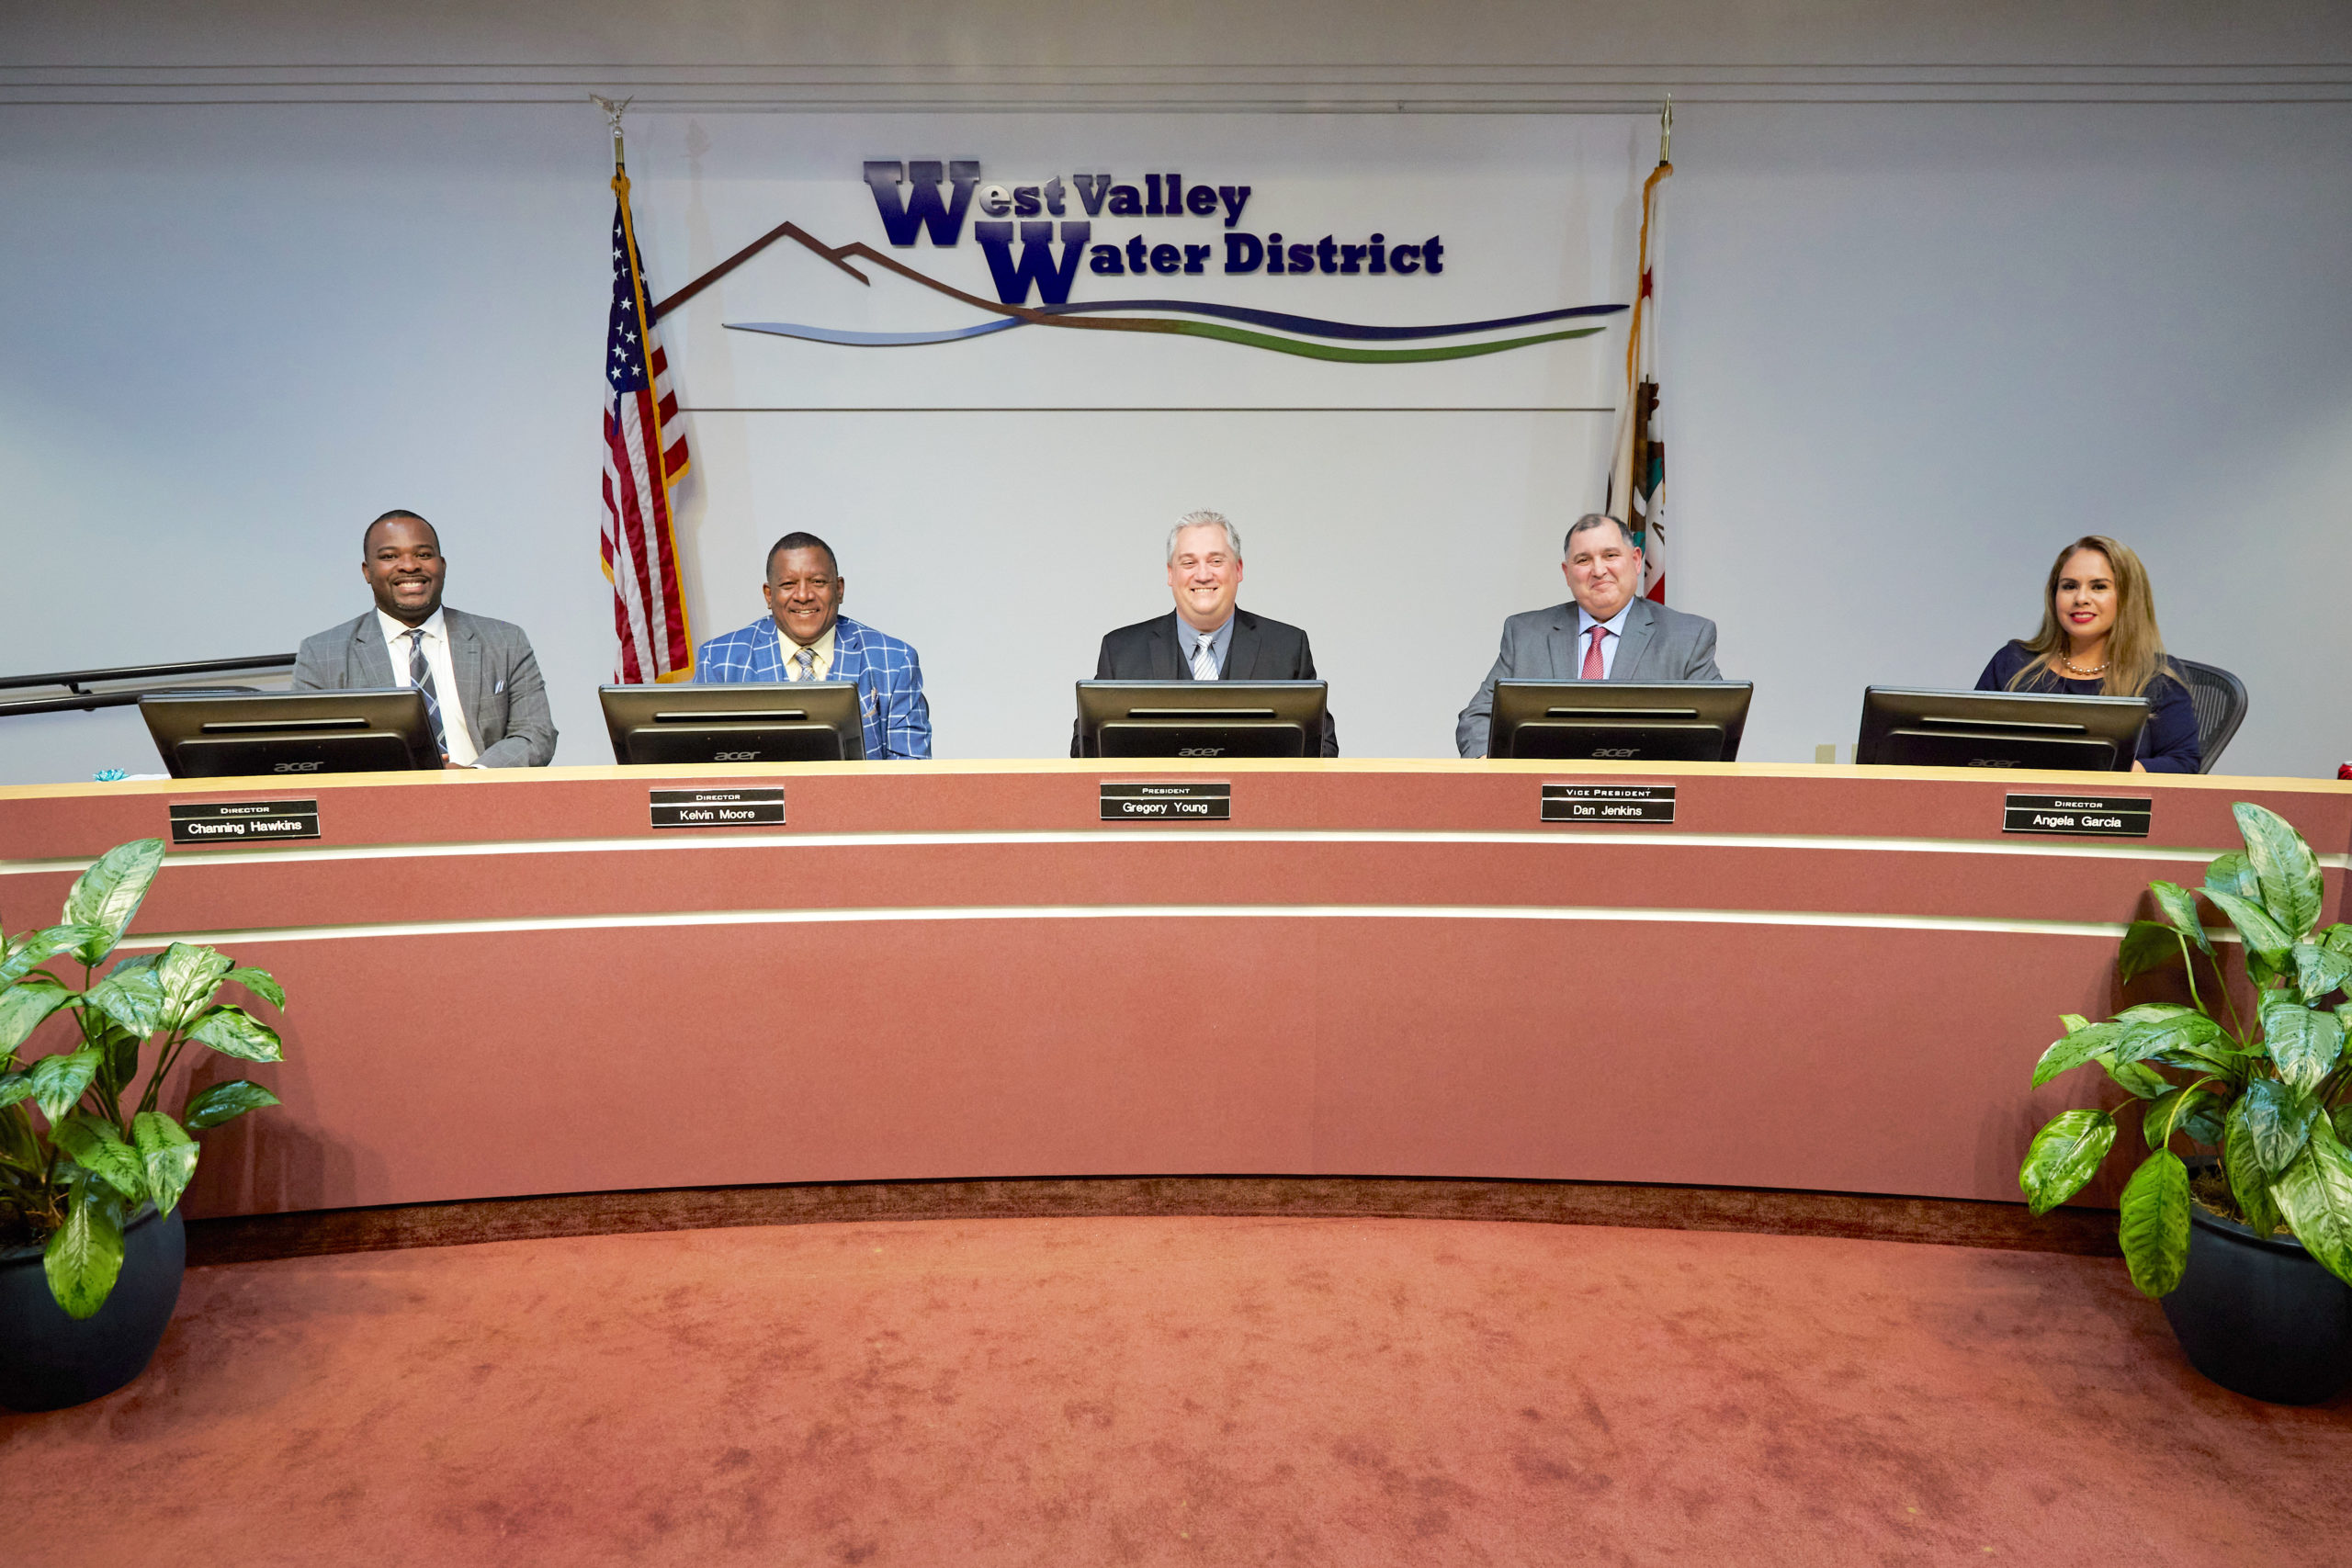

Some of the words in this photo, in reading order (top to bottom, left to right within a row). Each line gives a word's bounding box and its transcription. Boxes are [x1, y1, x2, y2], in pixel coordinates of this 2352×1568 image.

[863, 160, 1067, 247] West
[1073, 173, 1251, 228] Valley
[975, 220, 1211, 305] Water
[1224, 232, 1444, 275] District
[714, 751, 762, 761] acer
[1178, 748, 1226, 757] acer
[1591, 748, 1641, 758] acer
[274, 761, 324, 773] acer
[1968, 758, 2021, 768] acer
[680, 809, 714, 820] Kelvin
[719, 809, 755, 819] Moore
[1122, 802, 1168, 815] Gregory
[1173, 802, 1208, 814] Young
[1573, 805, 1596, 816] Dan
[1600, 806, 1643, 817] Jenkins
[187, 821, 245, 835] Channing
[250, 819, 303, 832] Hawkins
[2032, 814, 2075, 828] Angela
[2081, 816, 2122, 828] Garcia
